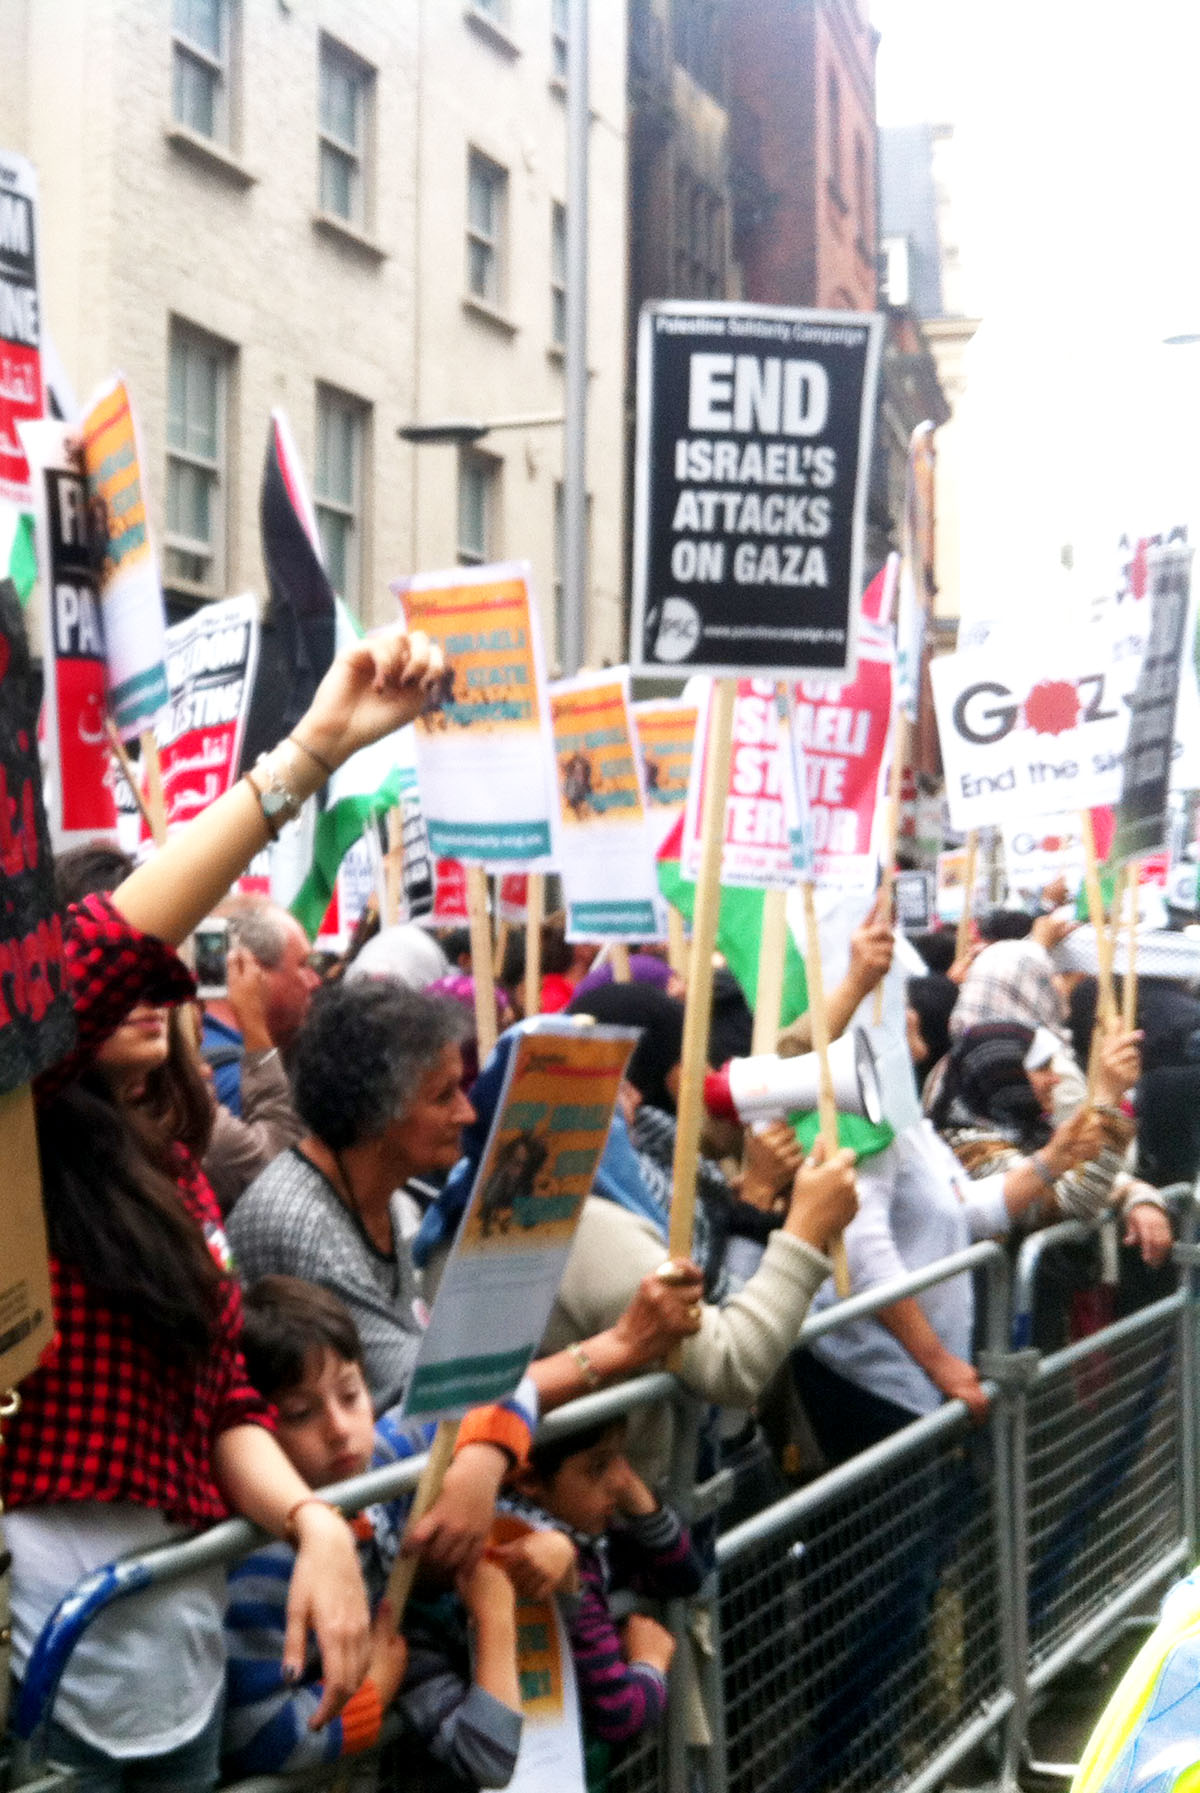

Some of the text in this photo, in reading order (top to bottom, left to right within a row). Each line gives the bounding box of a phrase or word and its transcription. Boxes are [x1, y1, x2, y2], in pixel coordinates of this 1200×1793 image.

[687, 352, 829, 437] END
[674, 438, 837, 489] ISRAEL'S
[671, 489, 832, 538] ATTACKS
[671, 539, 829, 588] ON GAZA
[960, 767, 1017, 799] End
[1028, 760, 1080, 784] the
